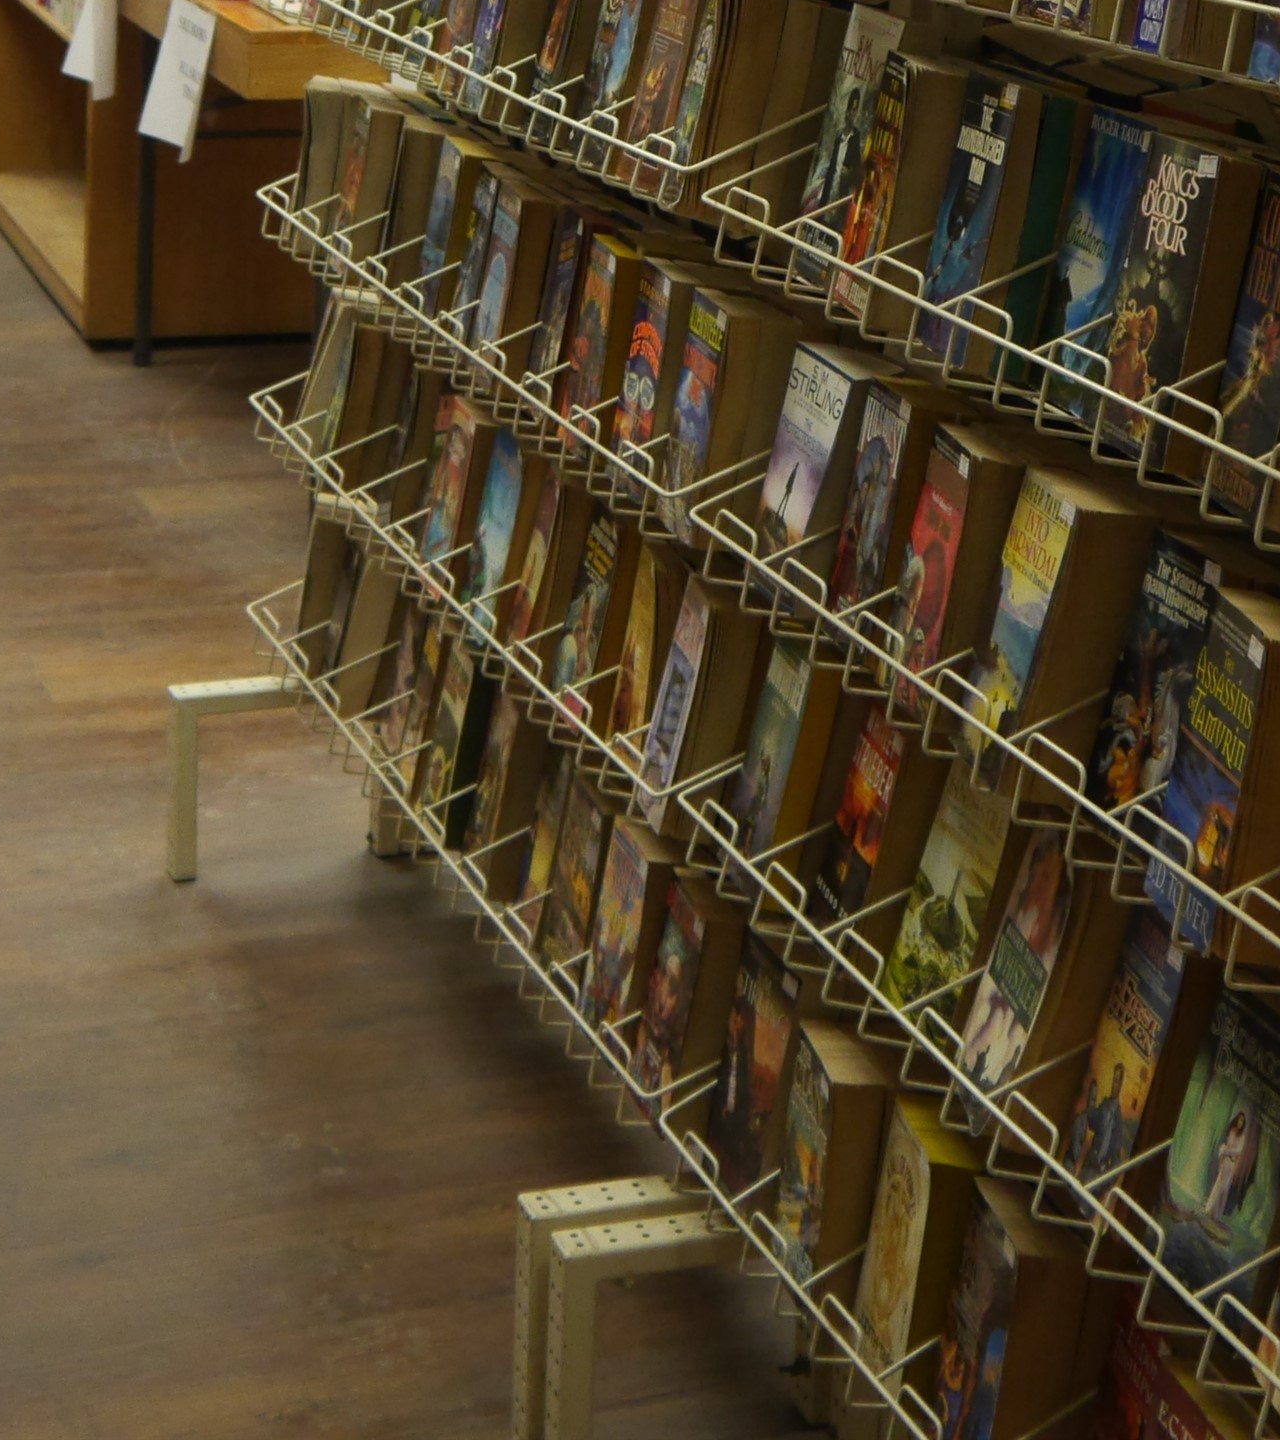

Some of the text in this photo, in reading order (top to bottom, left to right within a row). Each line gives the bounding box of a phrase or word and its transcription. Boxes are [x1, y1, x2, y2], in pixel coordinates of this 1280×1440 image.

[1156, 153, 1201, 200] KING'S
[1141, 178, 1189, 226] BLOOD
[1144, 218, 1189, 257] FOUR
[789, 367, 844, 420] STIRLING
[1025, 509, 1051, 544] INTO
